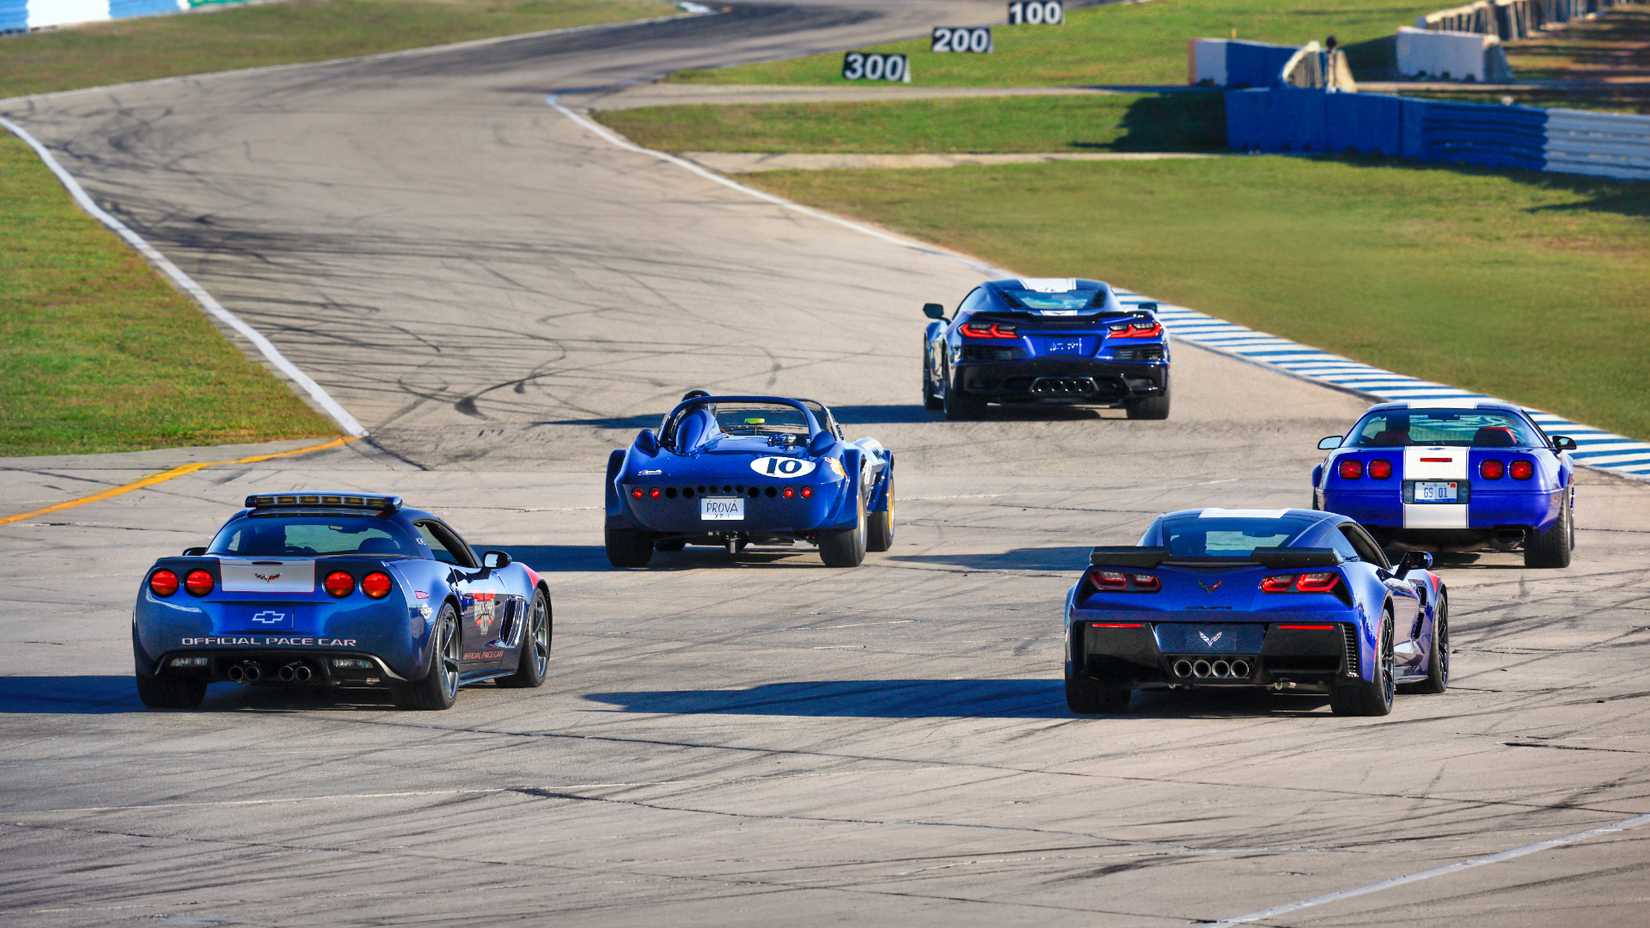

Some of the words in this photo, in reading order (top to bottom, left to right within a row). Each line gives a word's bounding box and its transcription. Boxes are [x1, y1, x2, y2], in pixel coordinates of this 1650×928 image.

[1009, 2, 1062, 24] 100
[932, 28, 988, 52] 200
[844, 53, 904, 80] 300
[766, 458, 802, 474] 10
[706, 502, 738, 513] PROVA
[181, 637, 261, 646] OFFICIAL
[265, 637, 313, 646] PACE
[317, 638, 357, 647] CAR
